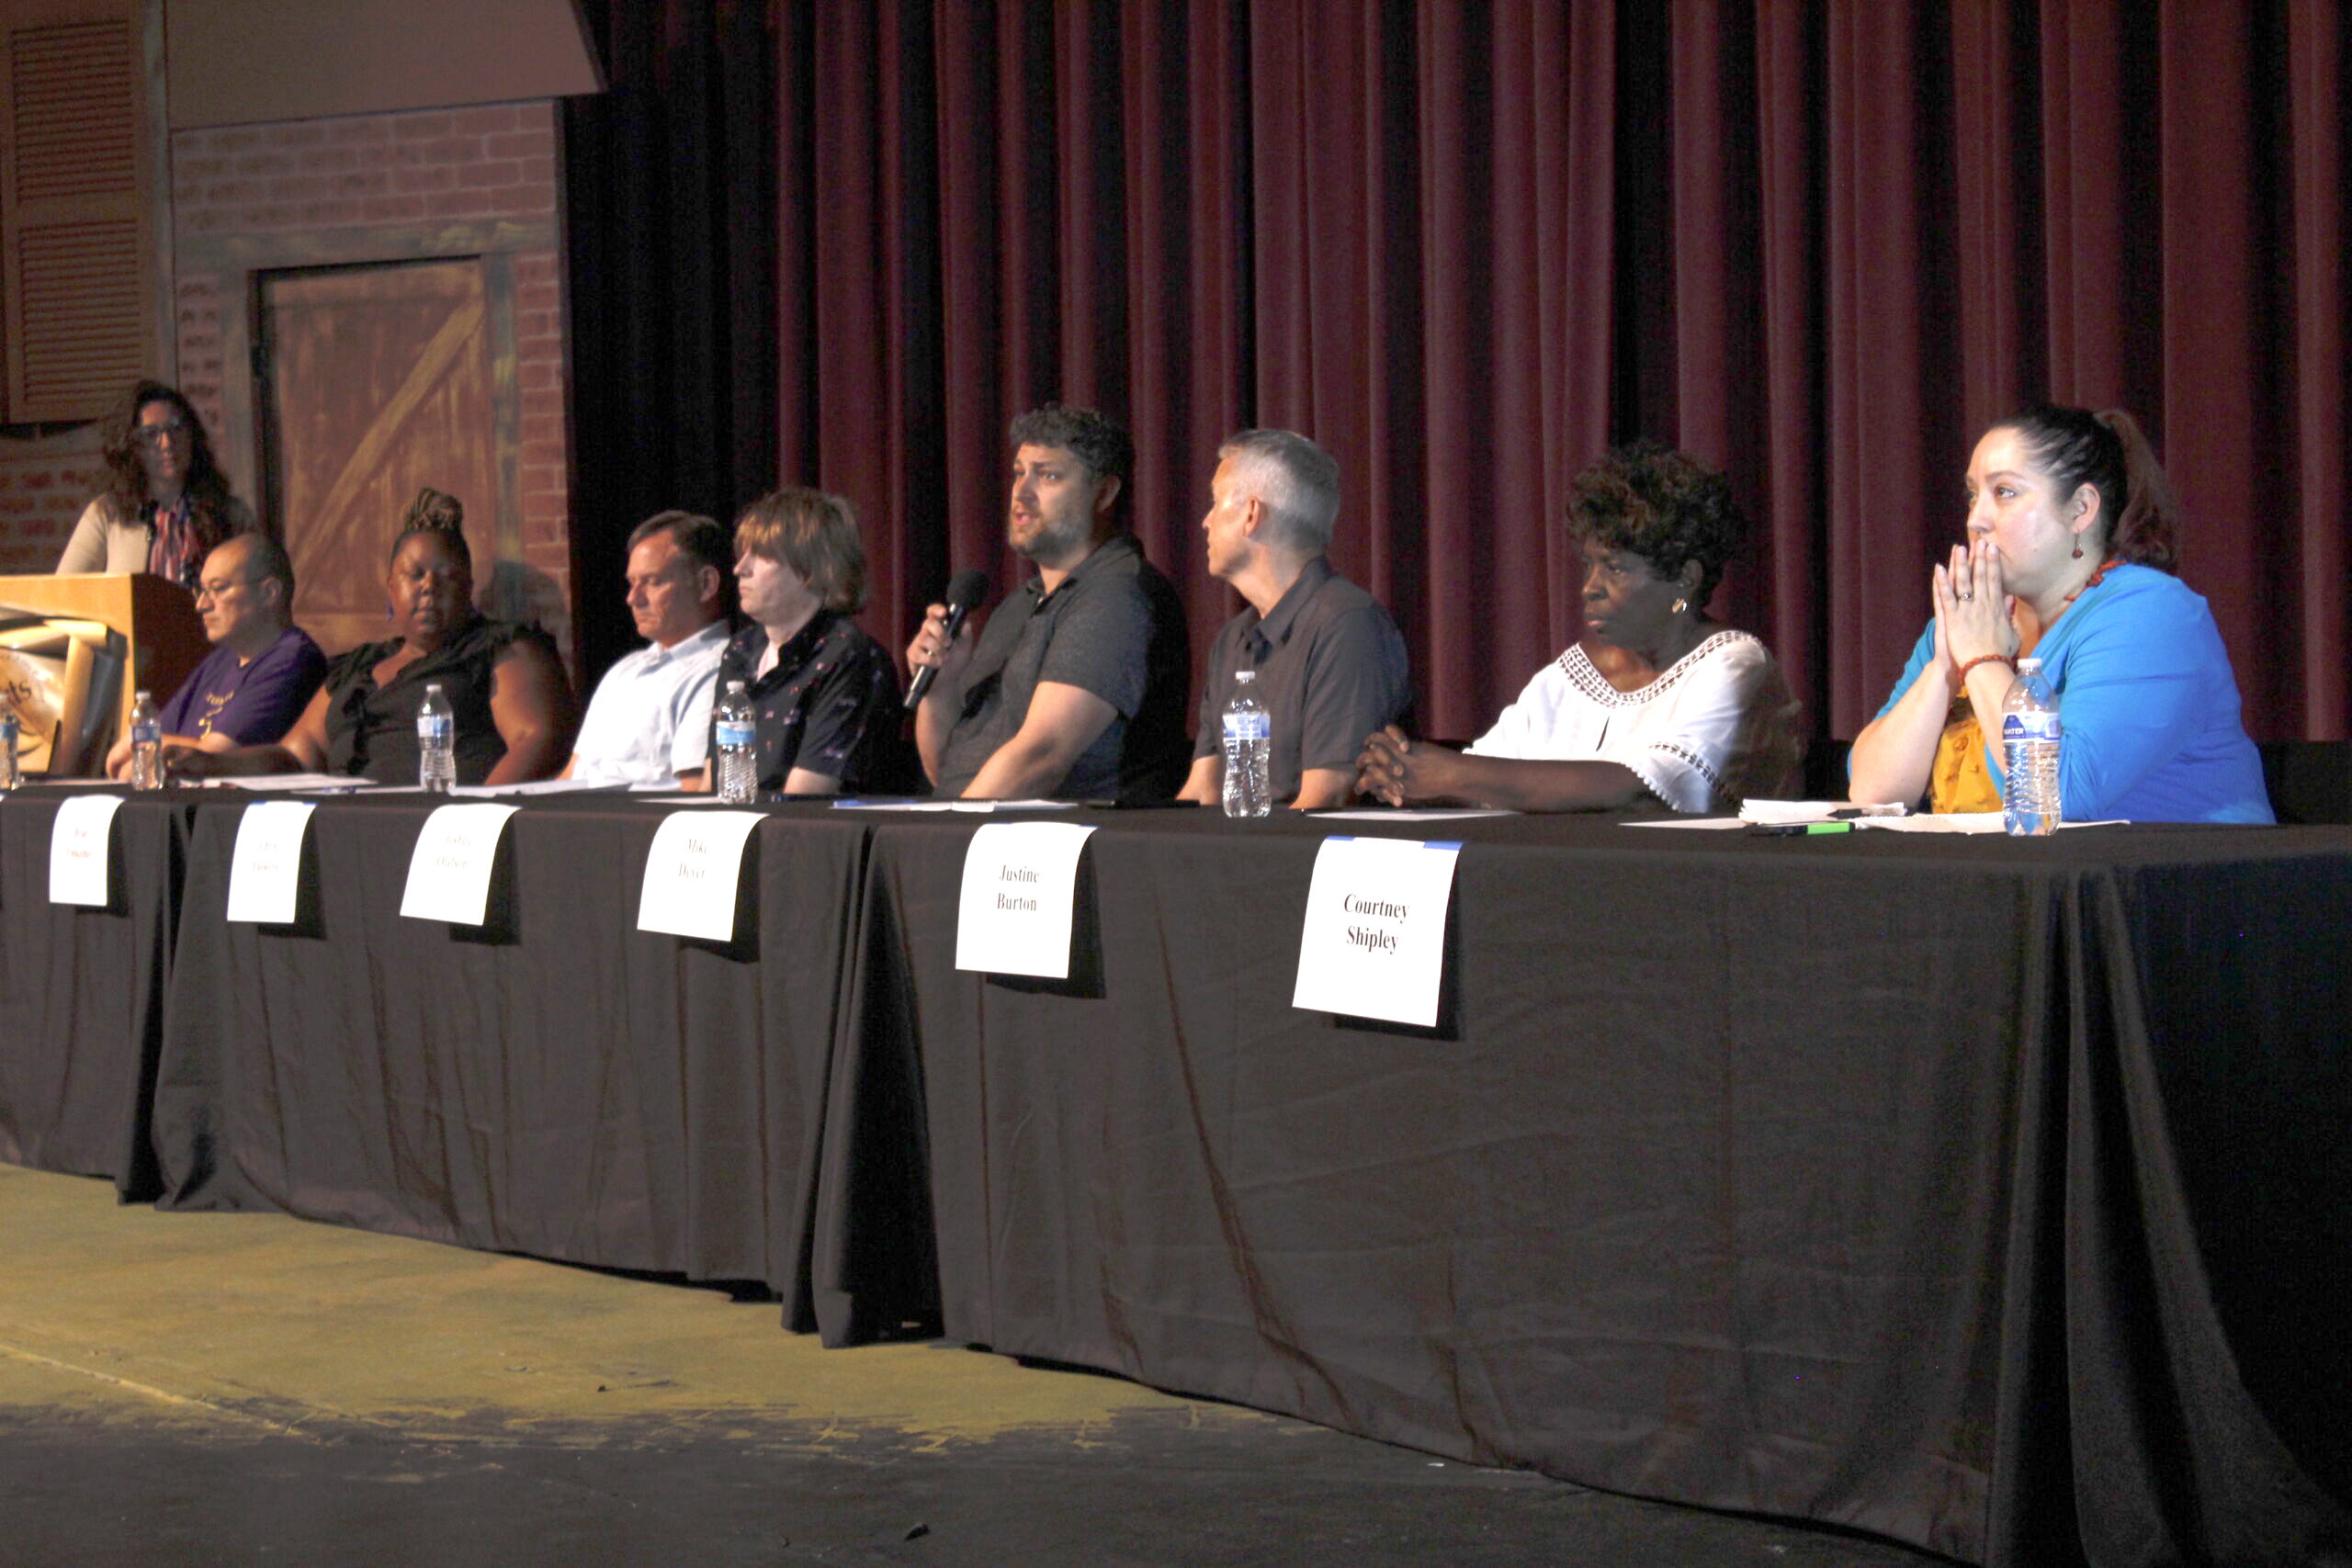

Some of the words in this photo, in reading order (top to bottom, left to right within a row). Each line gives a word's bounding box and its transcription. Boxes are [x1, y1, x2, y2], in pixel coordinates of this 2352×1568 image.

[999, 864, 1040, 884] Justine
[997, 892, 1037, 912] Burton
[1343, 893, 1410, 925] Courtney
[1346, 924, 1399, 956] Shipley
